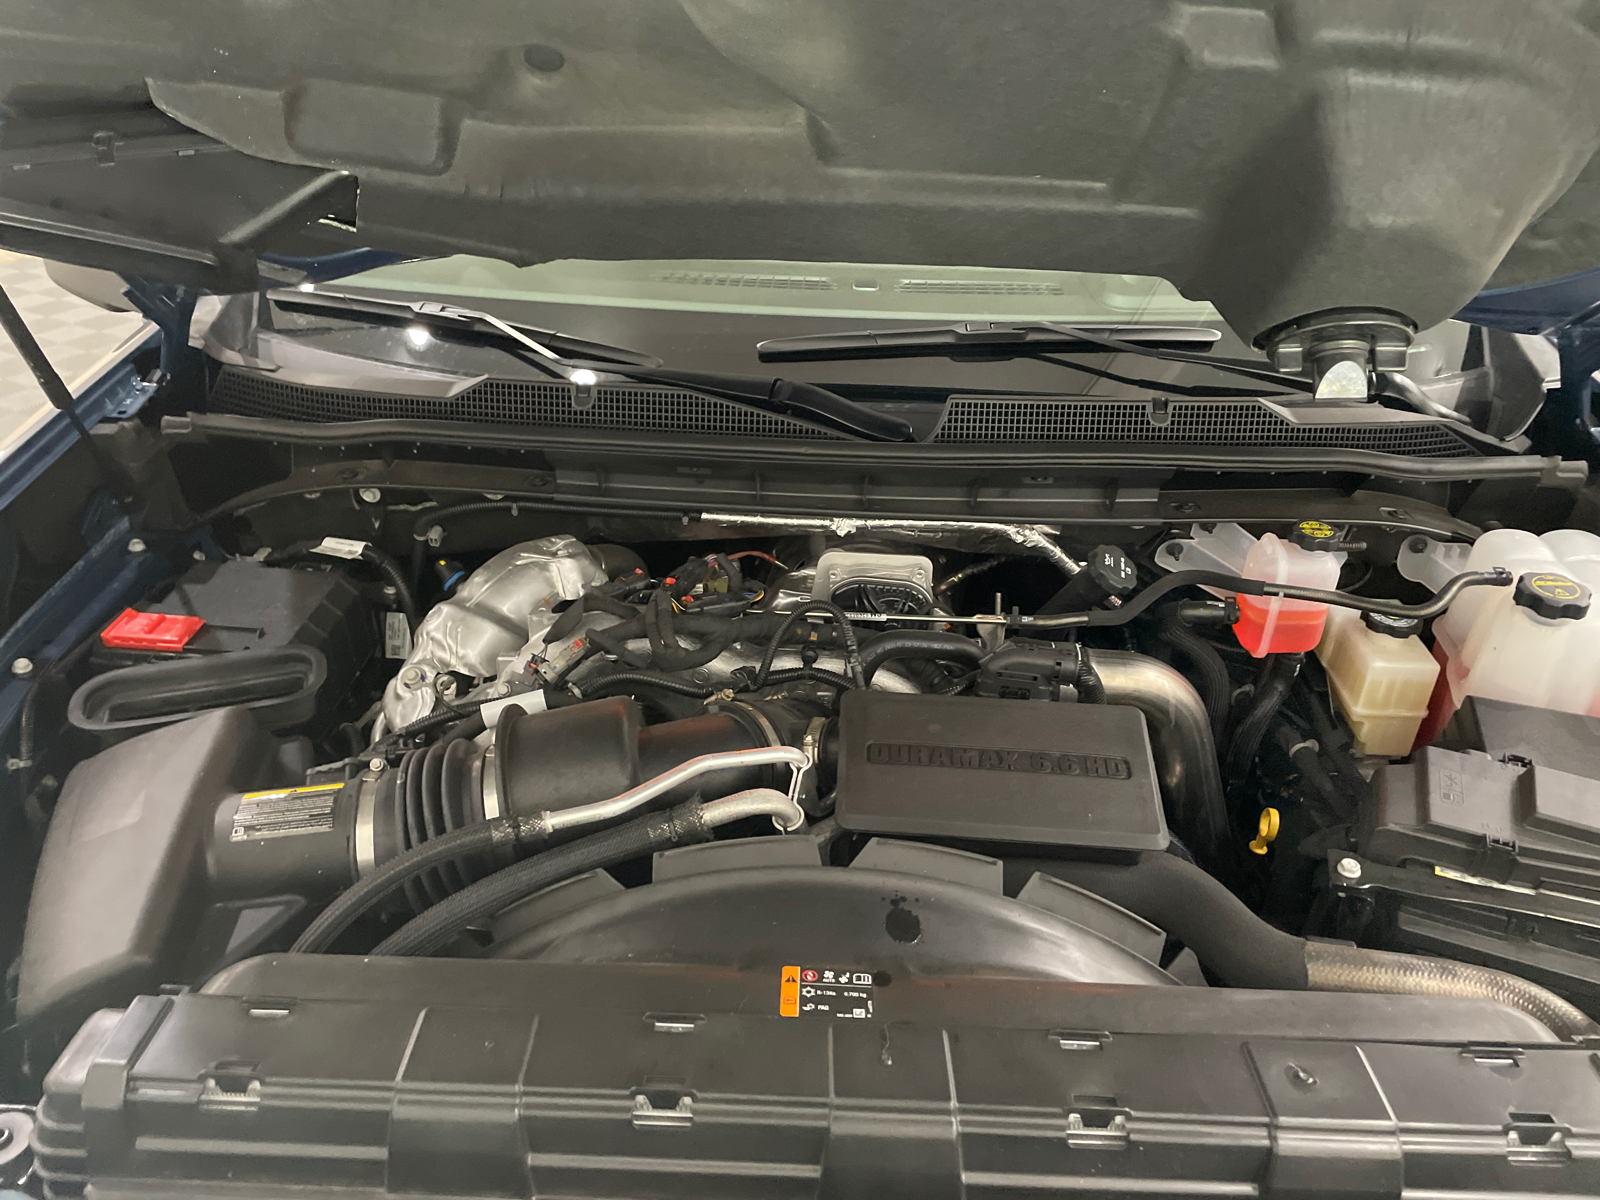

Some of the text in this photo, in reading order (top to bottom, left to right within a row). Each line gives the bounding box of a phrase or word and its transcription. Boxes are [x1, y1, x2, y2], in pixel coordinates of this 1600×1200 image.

[870, 744, 1128, 778] DURAMAX 6.6 HD
